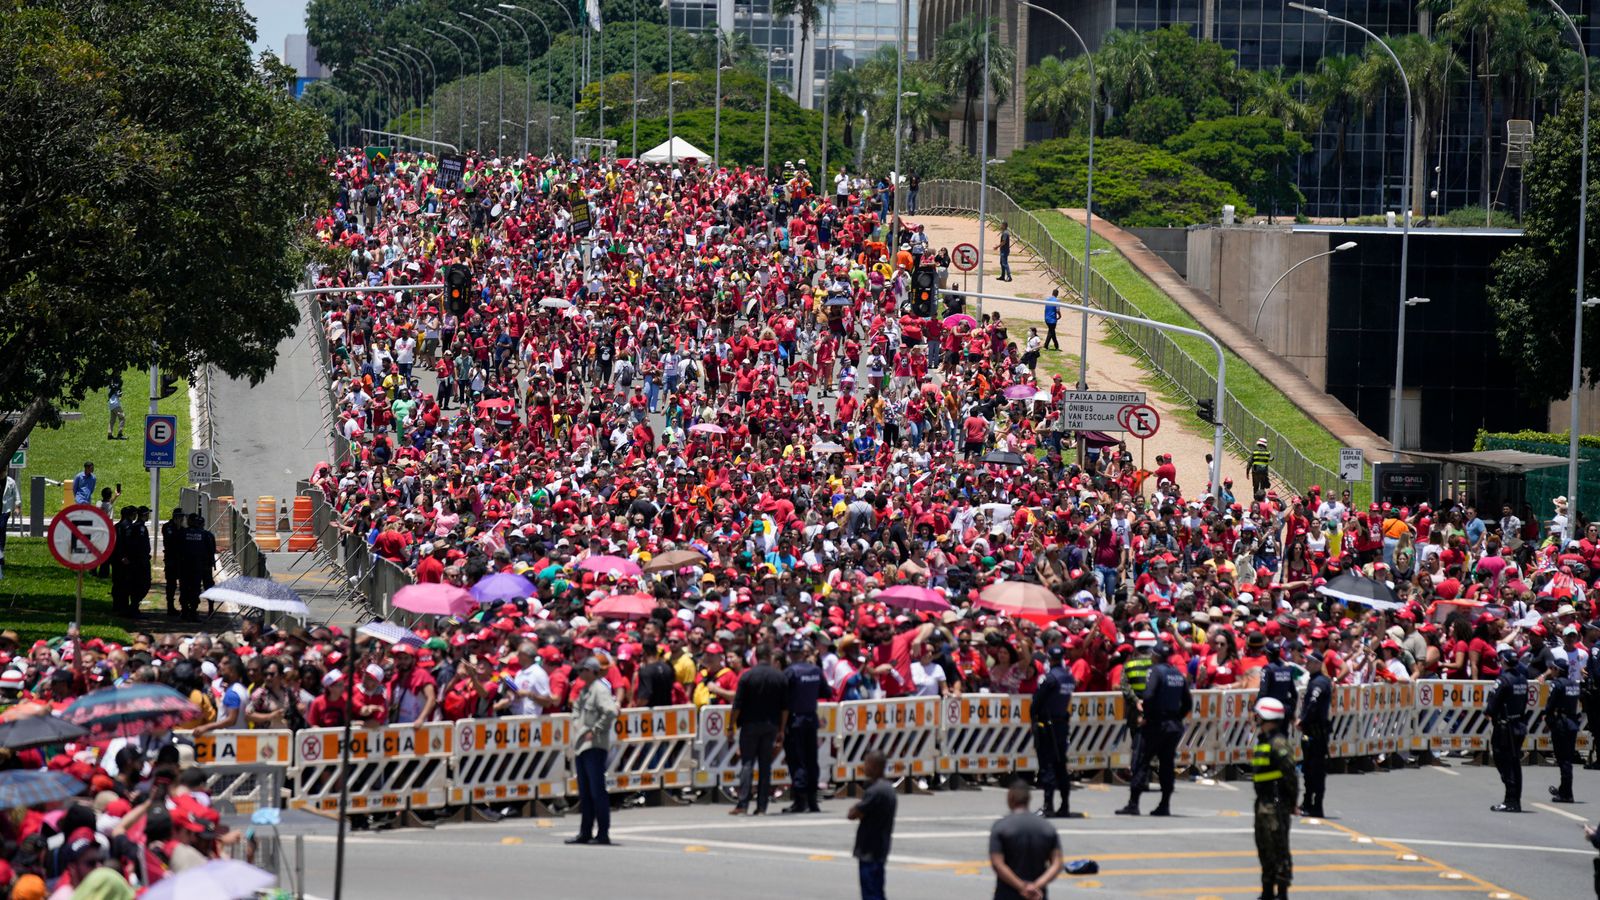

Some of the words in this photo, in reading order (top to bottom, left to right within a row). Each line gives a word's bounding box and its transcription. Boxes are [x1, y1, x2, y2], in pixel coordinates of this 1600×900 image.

[961, 250, 970, 264] E
[1110, 394, 1140, 402] DIREITA
[1068, 404, 1093, 412] ÔNIBUS
[1068, 420, 1084, 428] TÁXI
[1138, 413, 1149, 430] E
[155, 425, 165, 439] E
[196, 456, 204, 466] E
[71, 520, 93, 554] E
[614, 717, 666, 735] OLÍCIA
